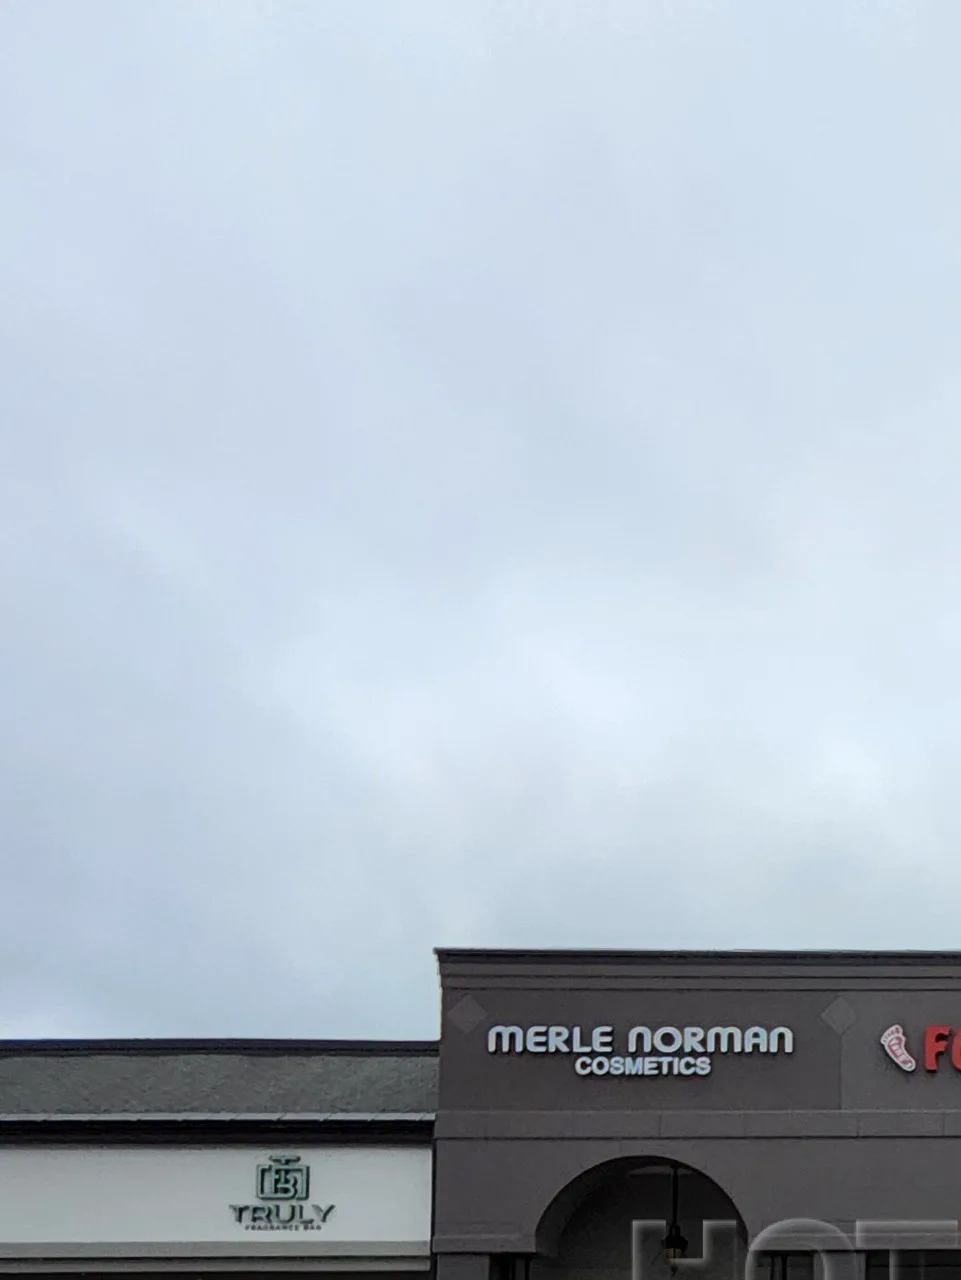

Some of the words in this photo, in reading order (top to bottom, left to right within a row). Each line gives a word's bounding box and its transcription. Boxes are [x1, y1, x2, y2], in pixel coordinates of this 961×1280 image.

[487, 1024, 613, 1054] MERLE
[628, 1024, 794, 1055] NORMAN
[574, 1055, 712, 1077] COSMETICS
[229, 1203, 337, 1225] TRULY
